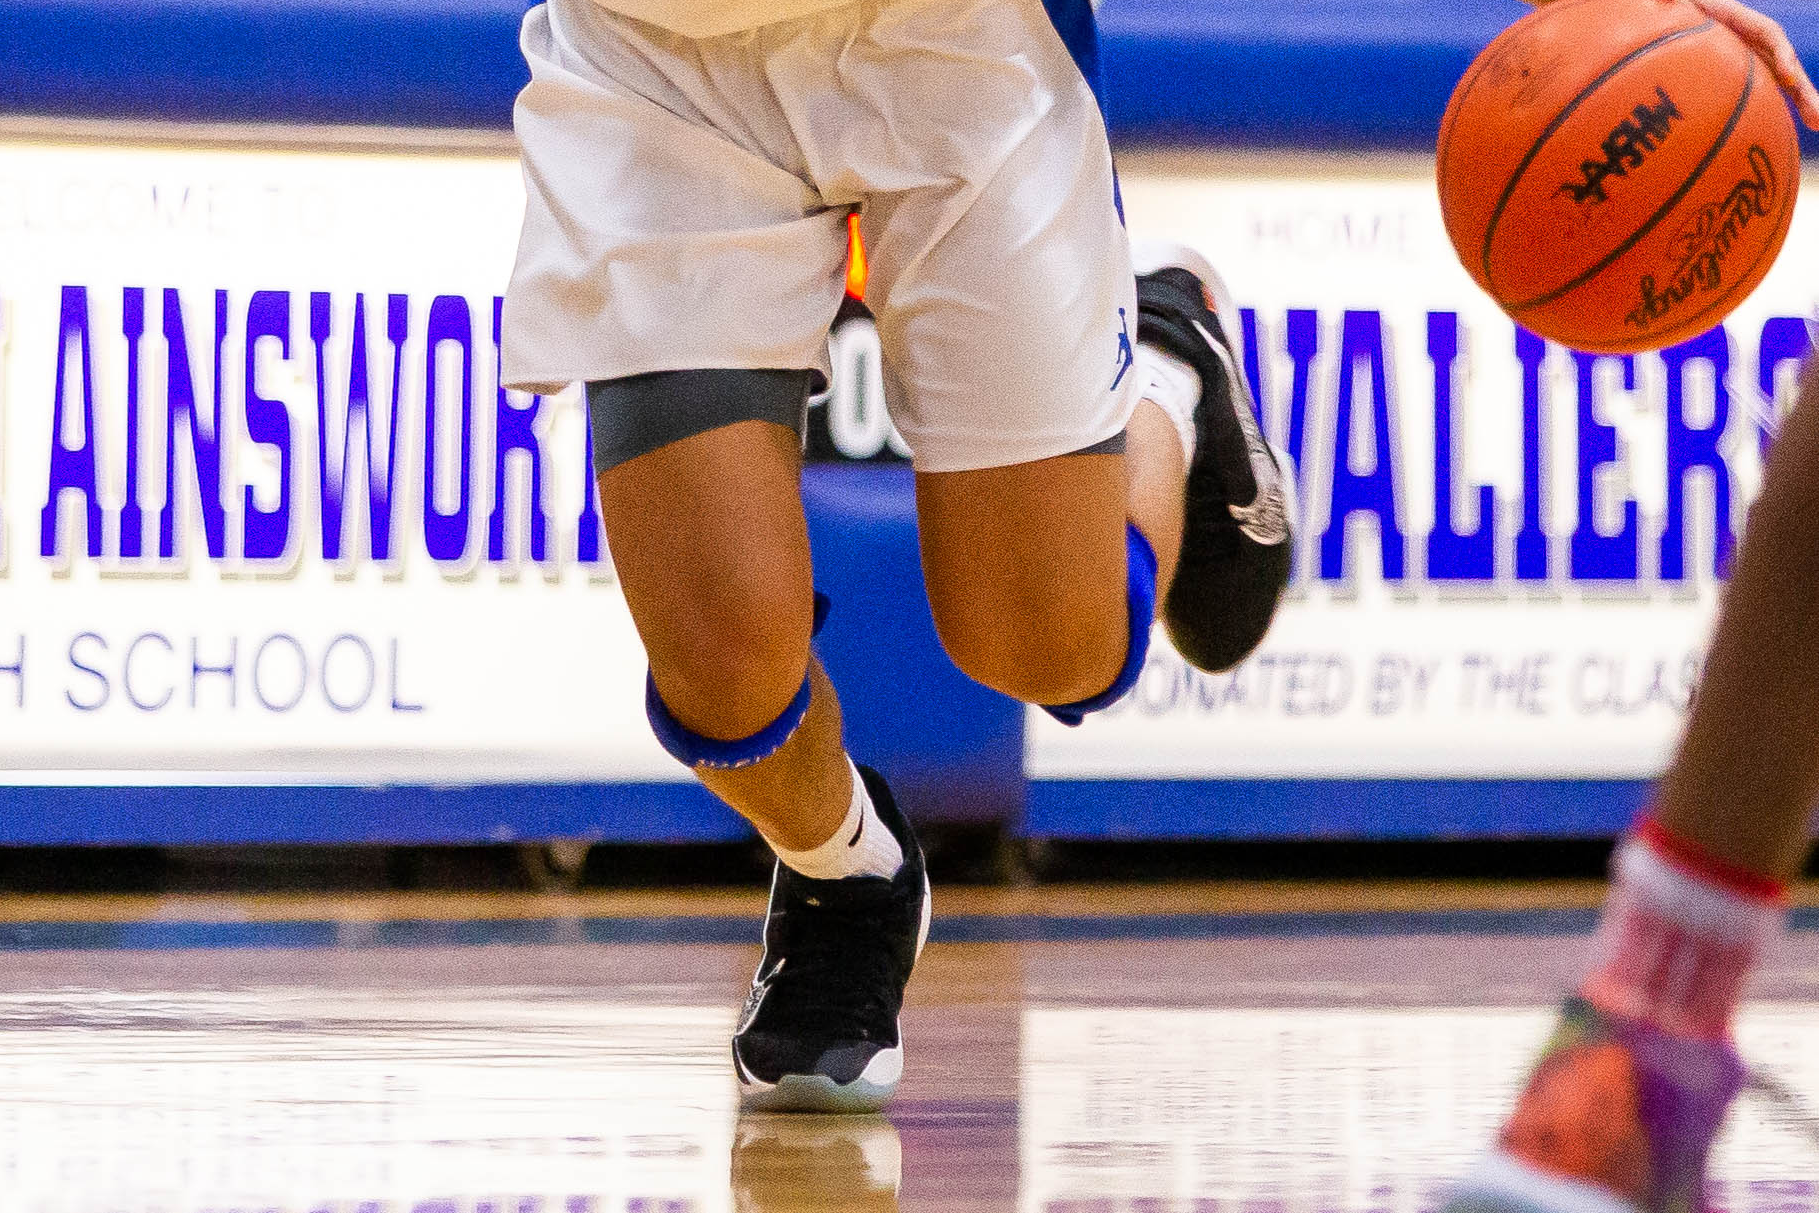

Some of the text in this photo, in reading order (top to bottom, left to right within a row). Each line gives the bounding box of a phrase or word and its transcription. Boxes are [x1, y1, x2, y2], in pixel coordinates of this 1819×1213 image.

[262, 180, 338, 238] TO
[1624, 144, 1776, 329] Rawlings
[40, 284, 599, 563] AINSWOR
[66, 631, 426, 714] SCHOOL
[1104, 650, 1702, 717] ONATED BY THE CLAS
